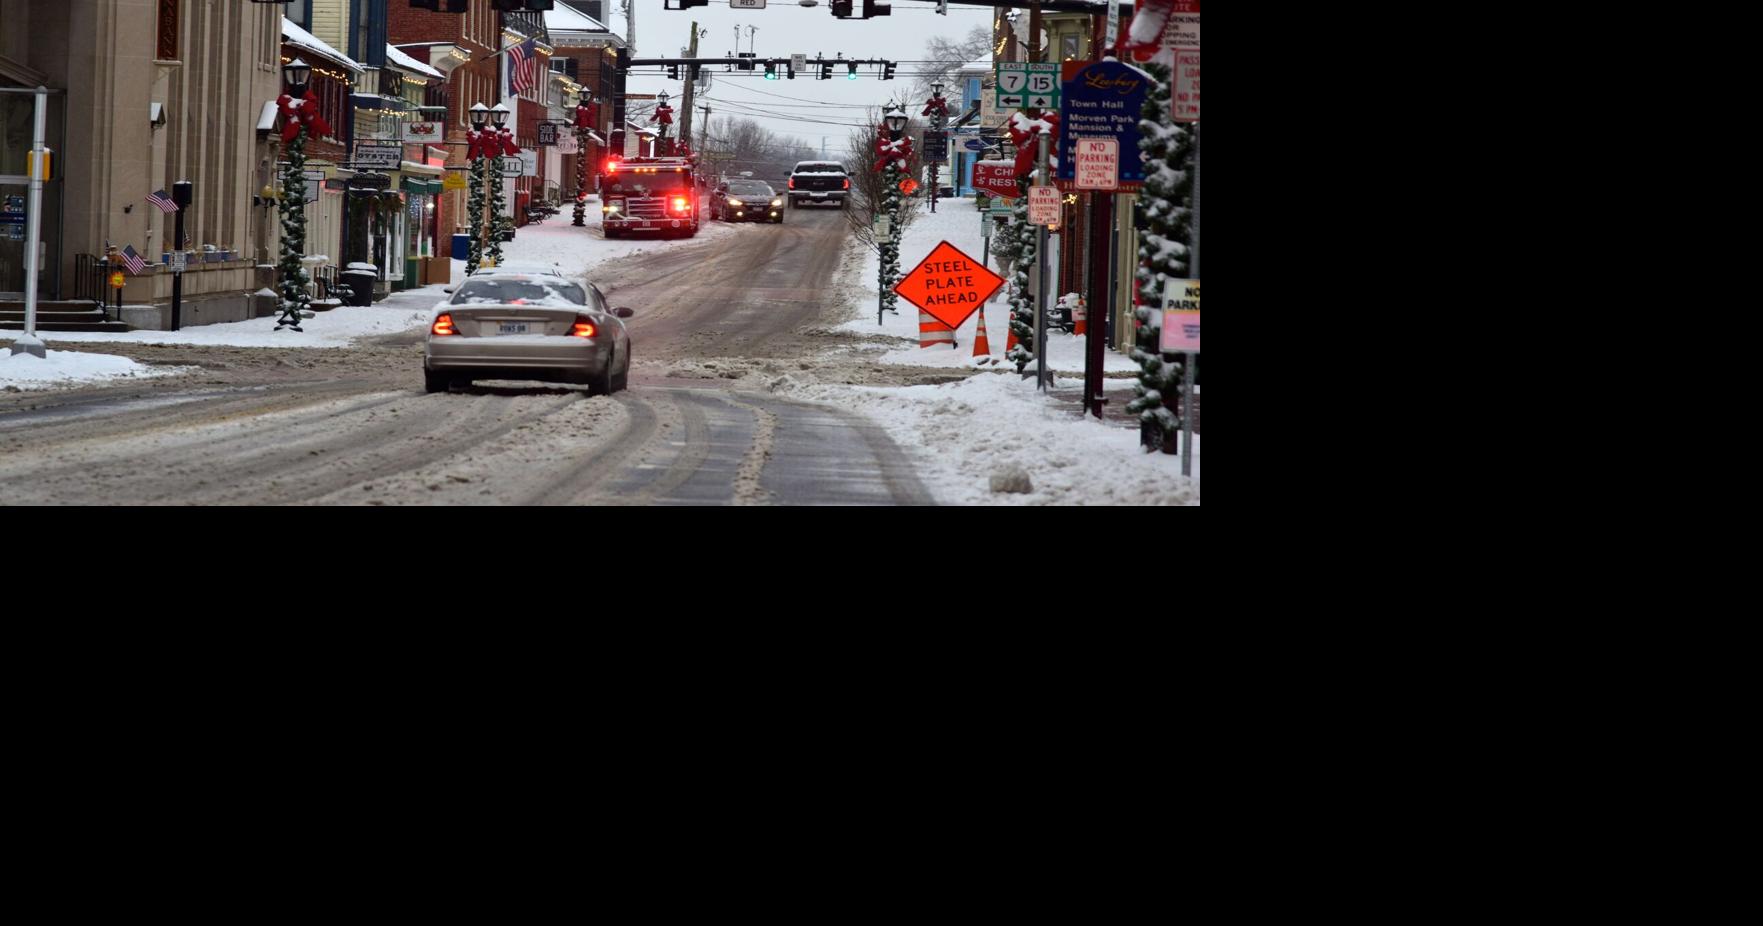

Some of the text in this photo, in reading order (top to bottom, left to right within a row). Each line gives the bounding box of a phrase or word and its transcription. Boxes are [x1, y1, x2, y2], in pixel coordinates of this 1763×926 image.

[1007, 76, 1050, 90] 7 15
[1070, 100, 1125, 109] Town Hall
[1068, 113, 1135, 123] Morven Park
[1068, 123, 1124, 132] Mansion &
[540, 133, 554, 143] BAR
[1090, 142, 1106, 152] NO
[1079, 153, 1115, 163] PARKING
[1080, 164, 1114, 172] LOADING
[1039, 188, 1051, 196] NO
[1031, 197, 1059, 205] PARKING
[924, 260, 972, 274] STEEL
[925, 275, 974, 290] PLATE
[925, 291, 978, 306] AHEAD
